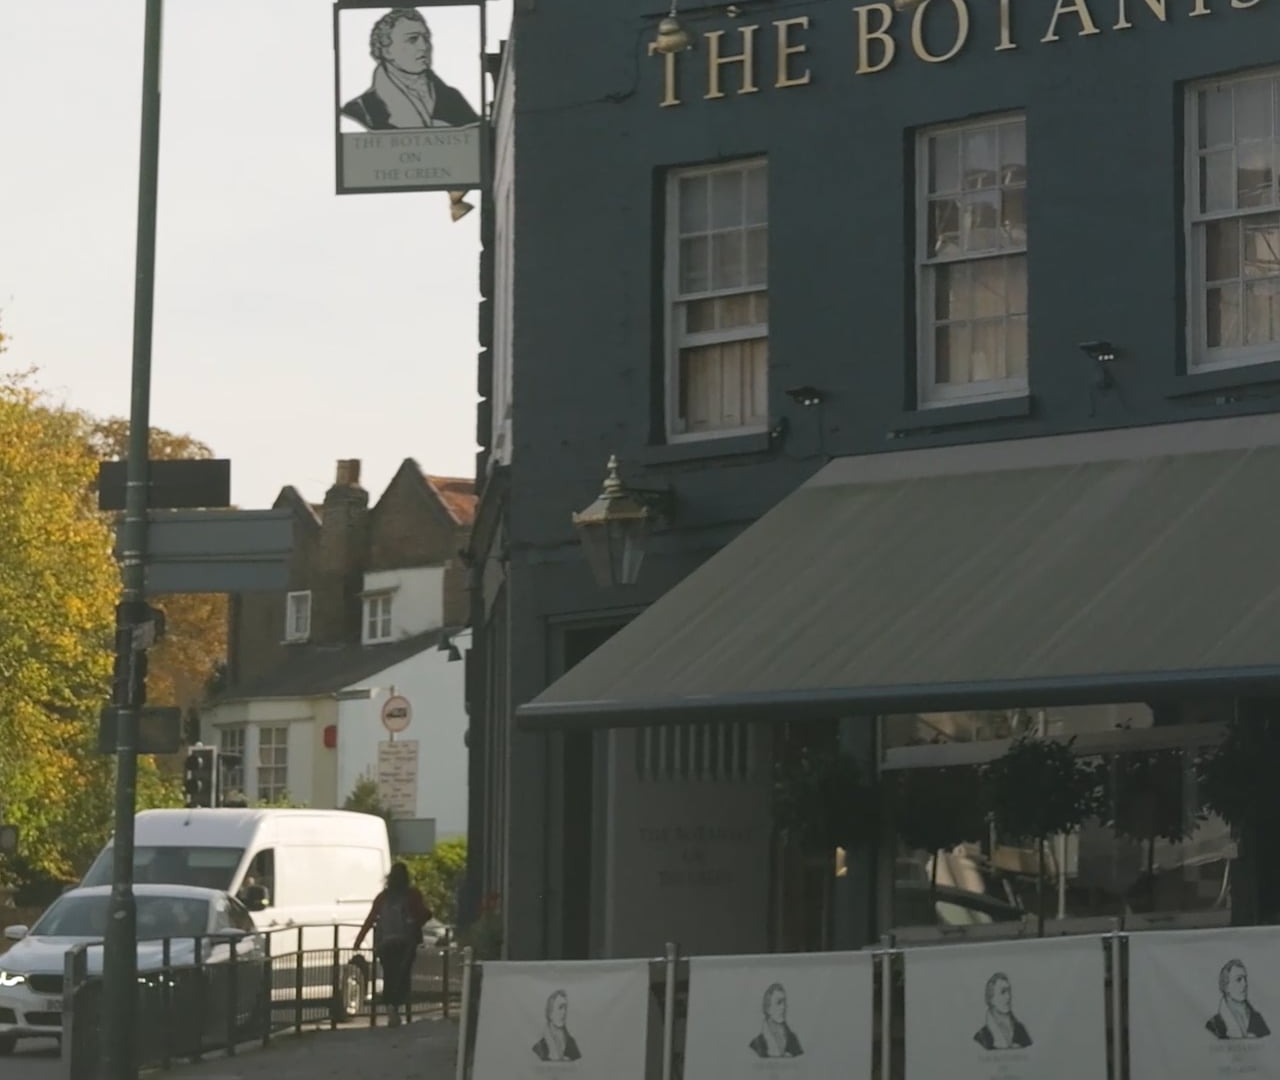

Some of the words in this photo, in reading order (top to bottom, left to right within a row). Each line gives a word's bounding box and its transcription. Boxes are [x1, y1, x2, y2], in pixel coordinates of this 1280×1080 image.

[648, 16, 811, 108] THE
[352, 136, 383, 149] THE
[391, 133, 472, 148] BOTANIST
[399, 152, 421, 163] ON
[373, 169, 400, 181] THE
[404, 167, 451, 180] GREEN
